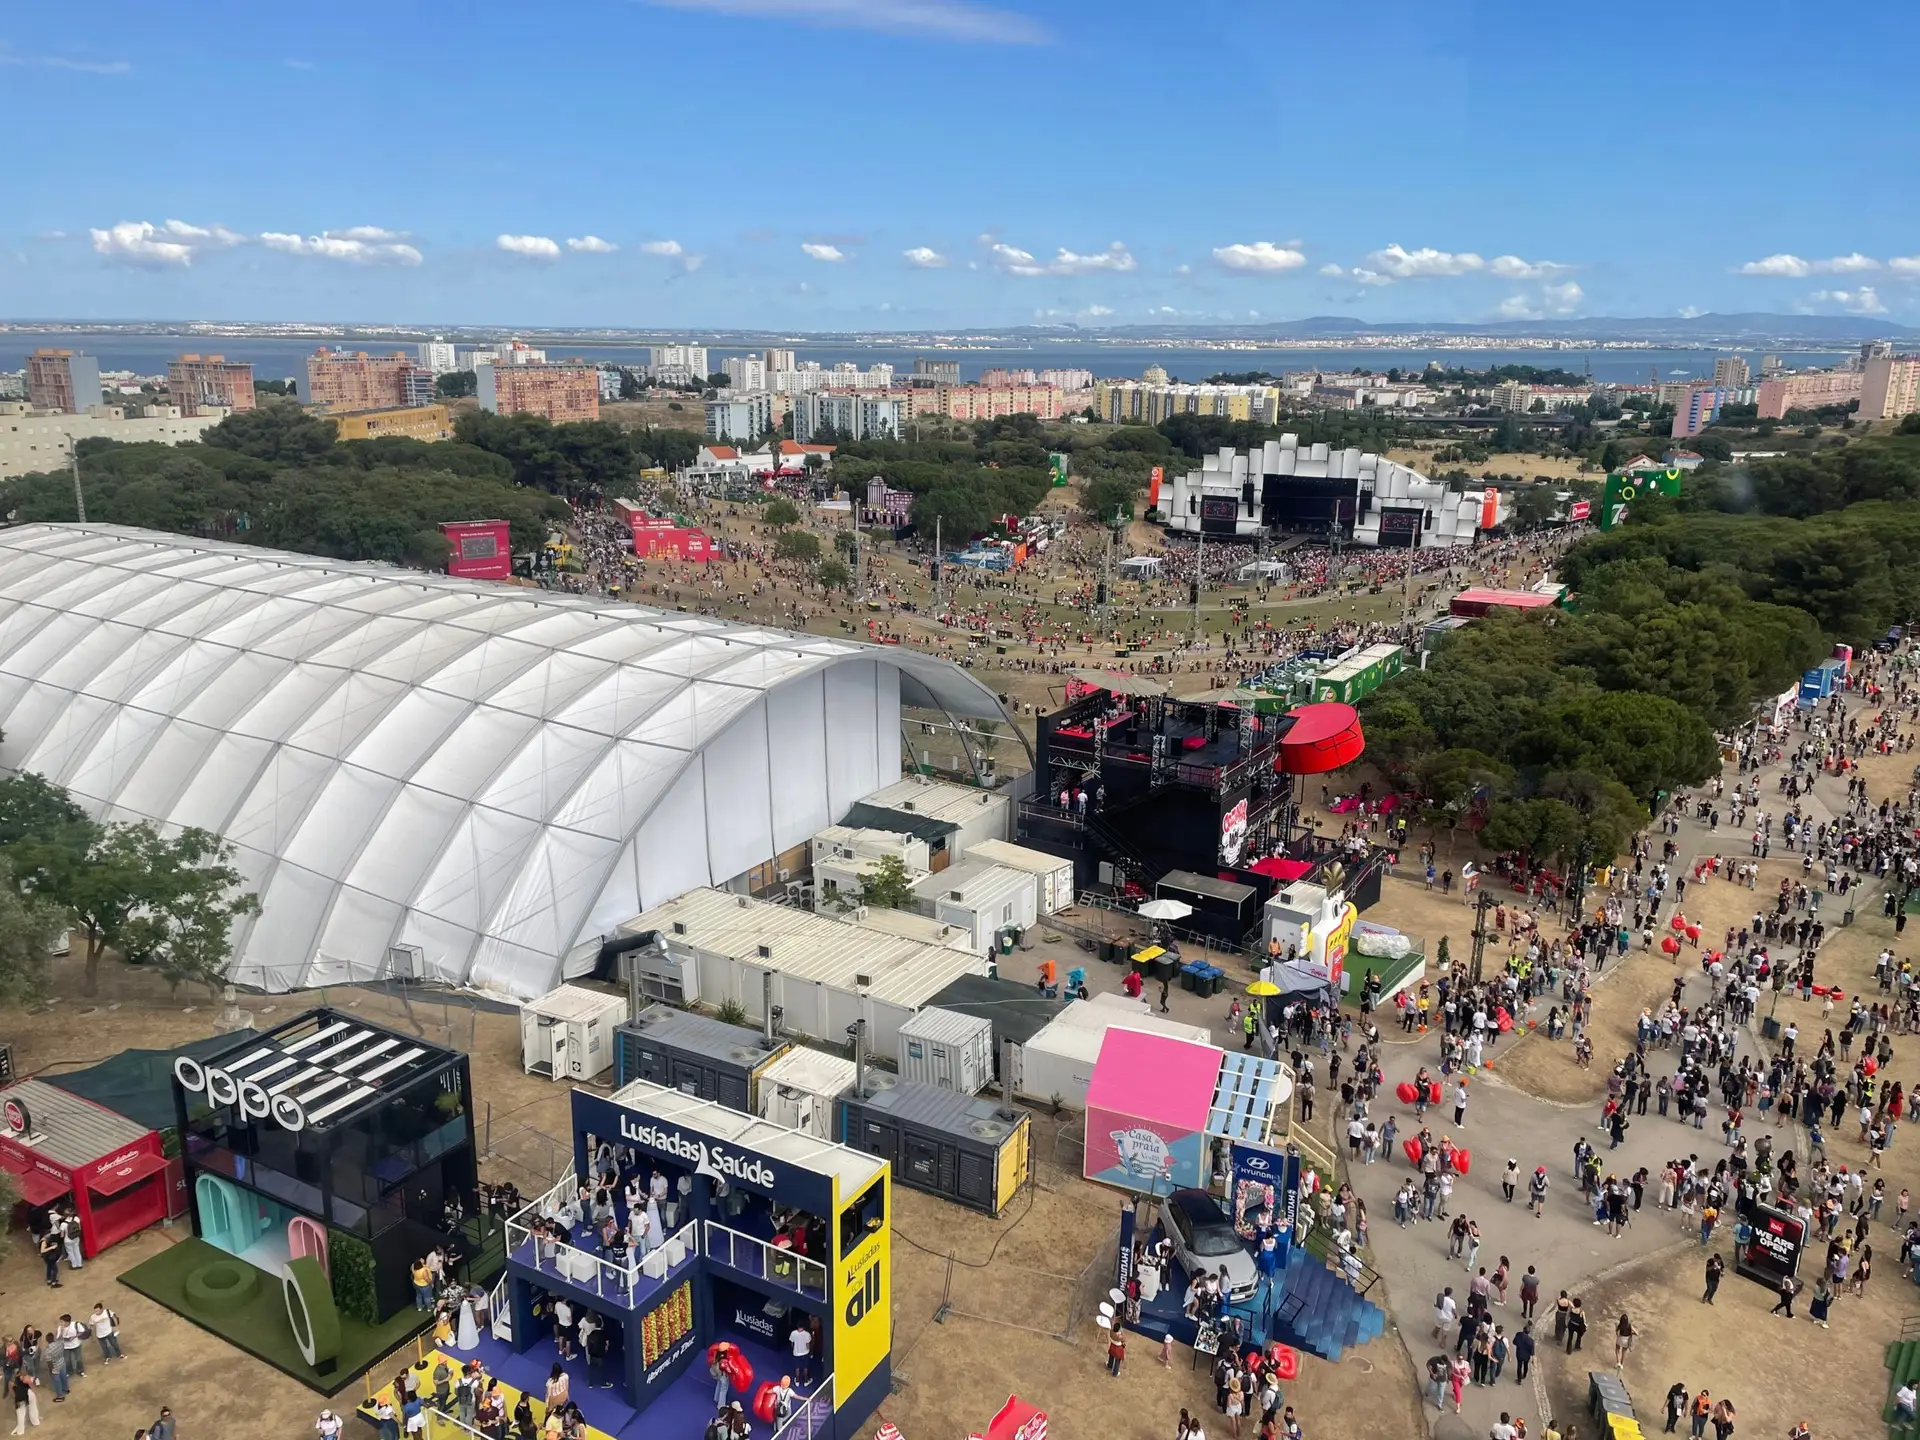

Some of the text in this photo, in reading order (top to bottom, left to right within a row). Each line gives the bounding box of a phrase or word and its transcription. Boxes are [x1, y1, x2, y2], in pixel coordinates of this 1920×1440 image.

[174, 1056, 305, 1132] oppo
[1128, 1129, 1152, 1144] Casa
[1132, 1139, 1161, 1154] praia
[620, 1114, 775, 1189] Lusíadas Saúde
[1240, 1167, 1275, 1180] HYUNDAI
[1755, 1227, 1773, 1241] WE
[1773, 1236, 1795, 1251] ARE
[1760, 1237, 1787, 1255] OPEN
[845, 1259, 880, 1327] all
